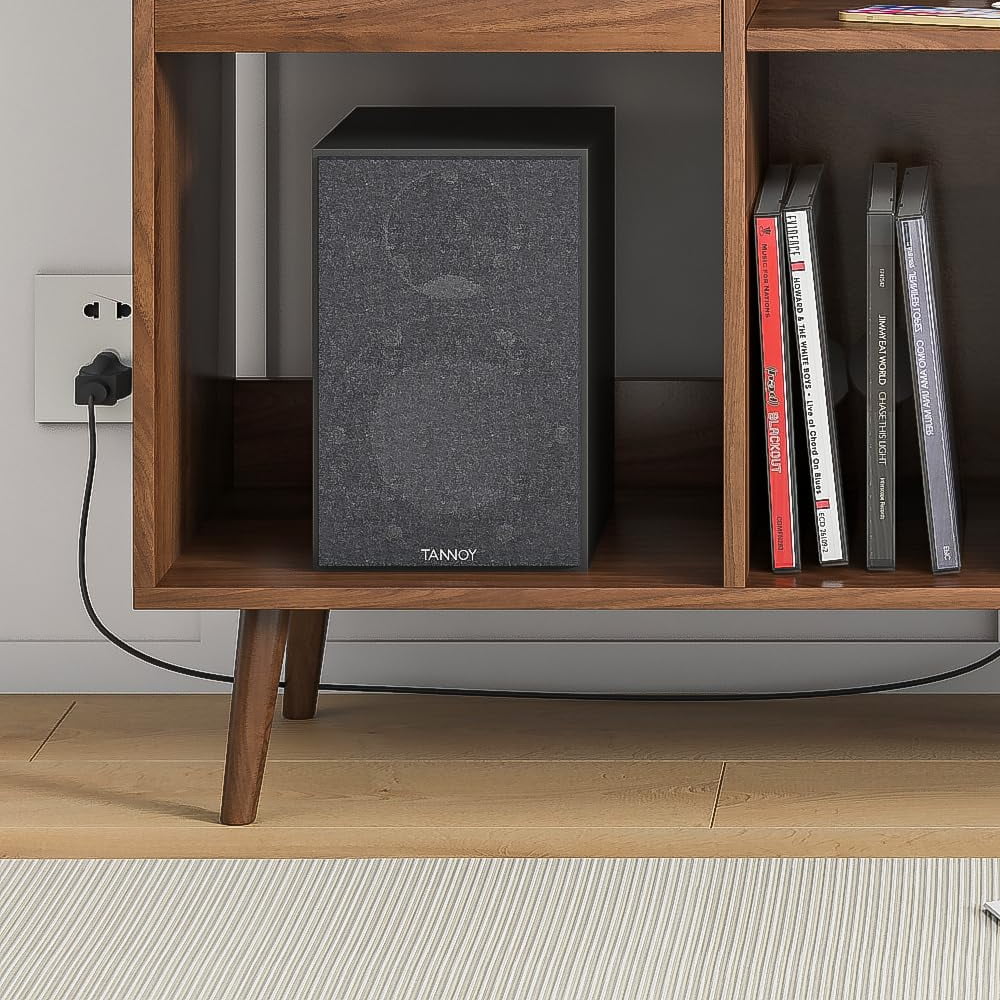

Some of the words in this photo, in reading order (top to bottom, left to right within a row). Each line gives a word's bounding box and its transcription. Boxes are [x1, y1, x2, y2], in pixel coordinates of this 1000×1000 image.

[761, 244, 769, 267] Music
[763, 285, 771, 318] Nations
[794, 277, 804, 313] HOWARD
[878, 314, 886, 339] JIMMY
[800, 341, 810, 365] WHITE
[878, 340, 886, 354] EAT
[803, 368, 812, 389] BOYS
[878, 355, 887, 385] WORLD
[807, 400, 815, 416] Live
[879, 391, 887, 419] CHASE
[809, 419, 816, 427] at
[879, 421, 887, 439] THIS
[768, 411, 782, 473] BLACKOUT
[810, 430, 819, 455] Chord
[879, 441, 887, 465] LIGHT
[813, 458, 821, 469] On
[814, 472, 823, 494] Blues
[420, 548, 478, 561] TANNOY
